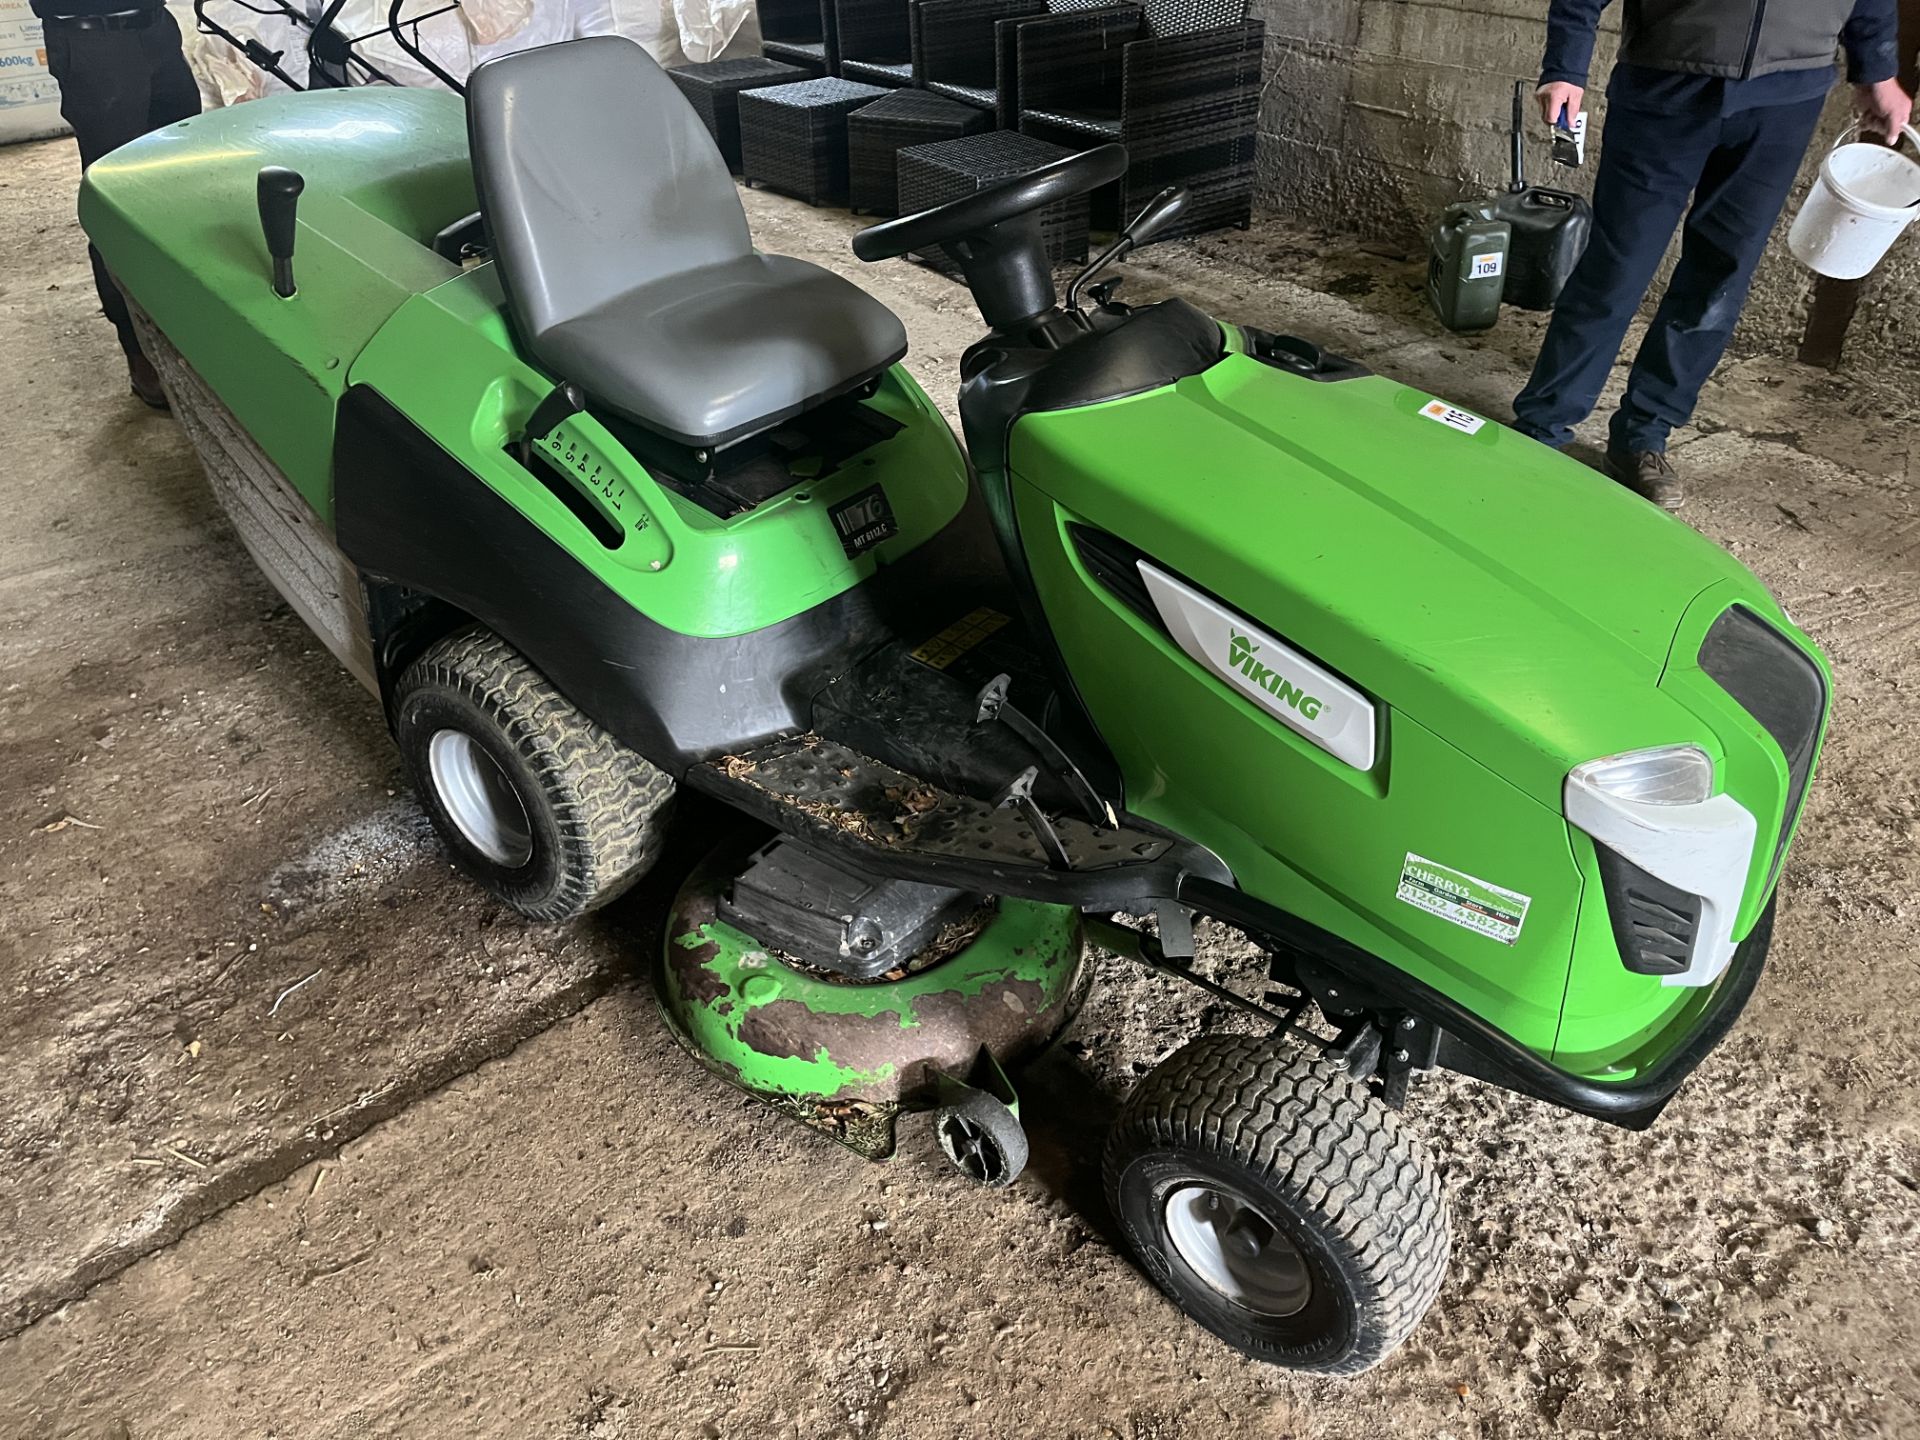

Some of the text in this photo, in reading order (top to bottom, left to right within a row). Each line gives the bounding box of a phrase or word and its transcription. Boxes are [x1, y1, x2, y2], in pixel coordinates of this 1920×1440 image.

[1477, 262, 1497, 274] 109
[1444, 410, 1474, 428] 115
[565, 451, 575, 462] 5
[577, 462, 586, 473] 4
[590, 474, 600, 486] 3
[602, 487, 613, 498] 2
[611, 501, 621, 511] 1
[853, 534, 866, 548] MT
[1229, 642, 1323, 721] VIKING
[1406, 865, 1470, 897] CHERRYS
[1400, 884, 1447, 910] 01262
[1454, 907, 1518, 936] 488275
